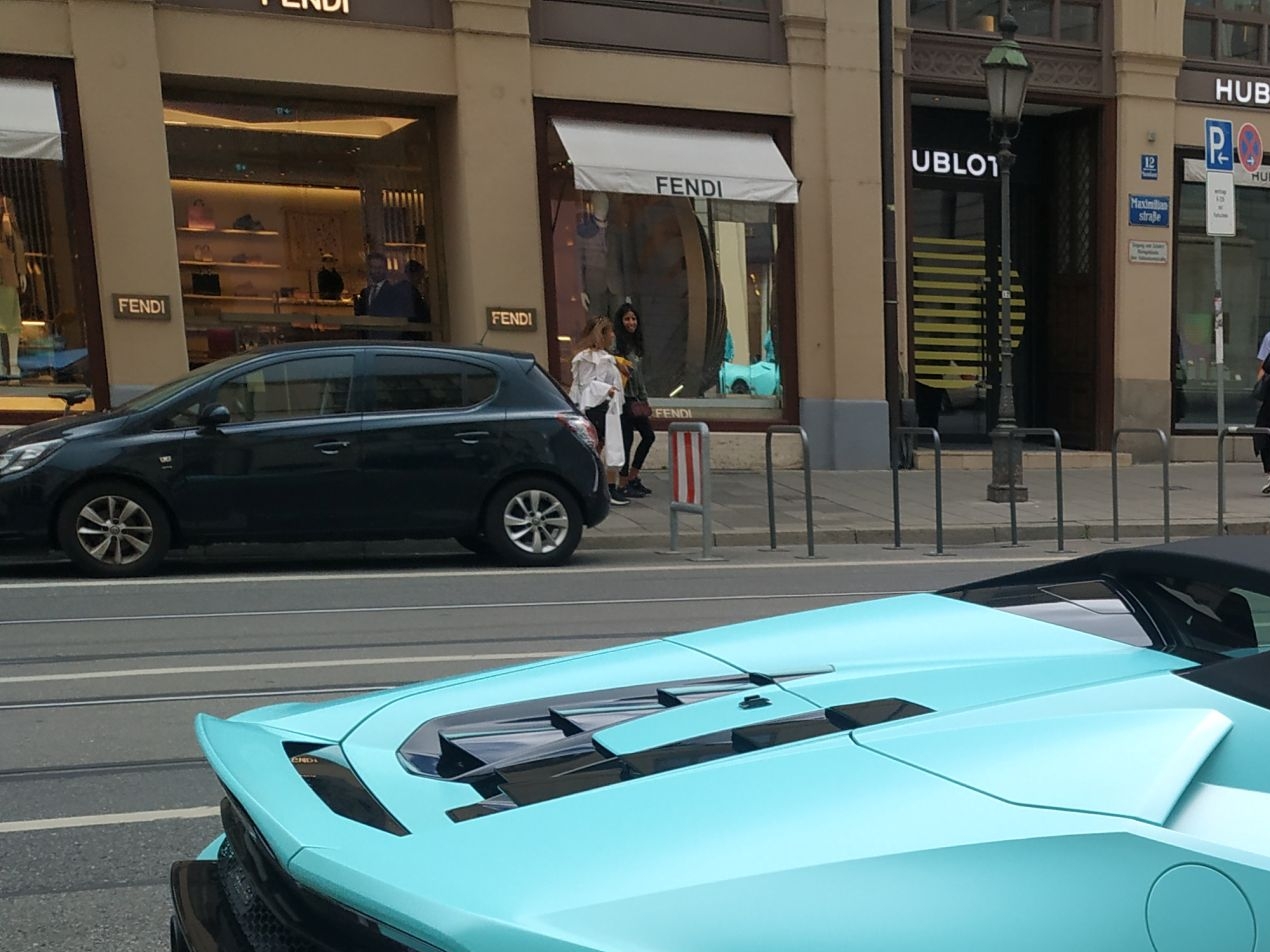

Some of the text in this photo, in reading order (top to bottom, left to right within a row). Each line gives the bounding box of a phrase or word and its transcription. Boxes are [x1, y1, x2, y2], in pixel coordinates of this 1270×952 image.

[1209, 126, 1225, 164] P
[912, 149, 998, 177] UBLOT
[1145, 156, 1156, 169] 12
[656, 175, 722, 198] FENDI
[118, 298, 165, 314] FENDI
[491, 311, 533, 326] FENDI
[655, 408, 692, 418] FENDI
